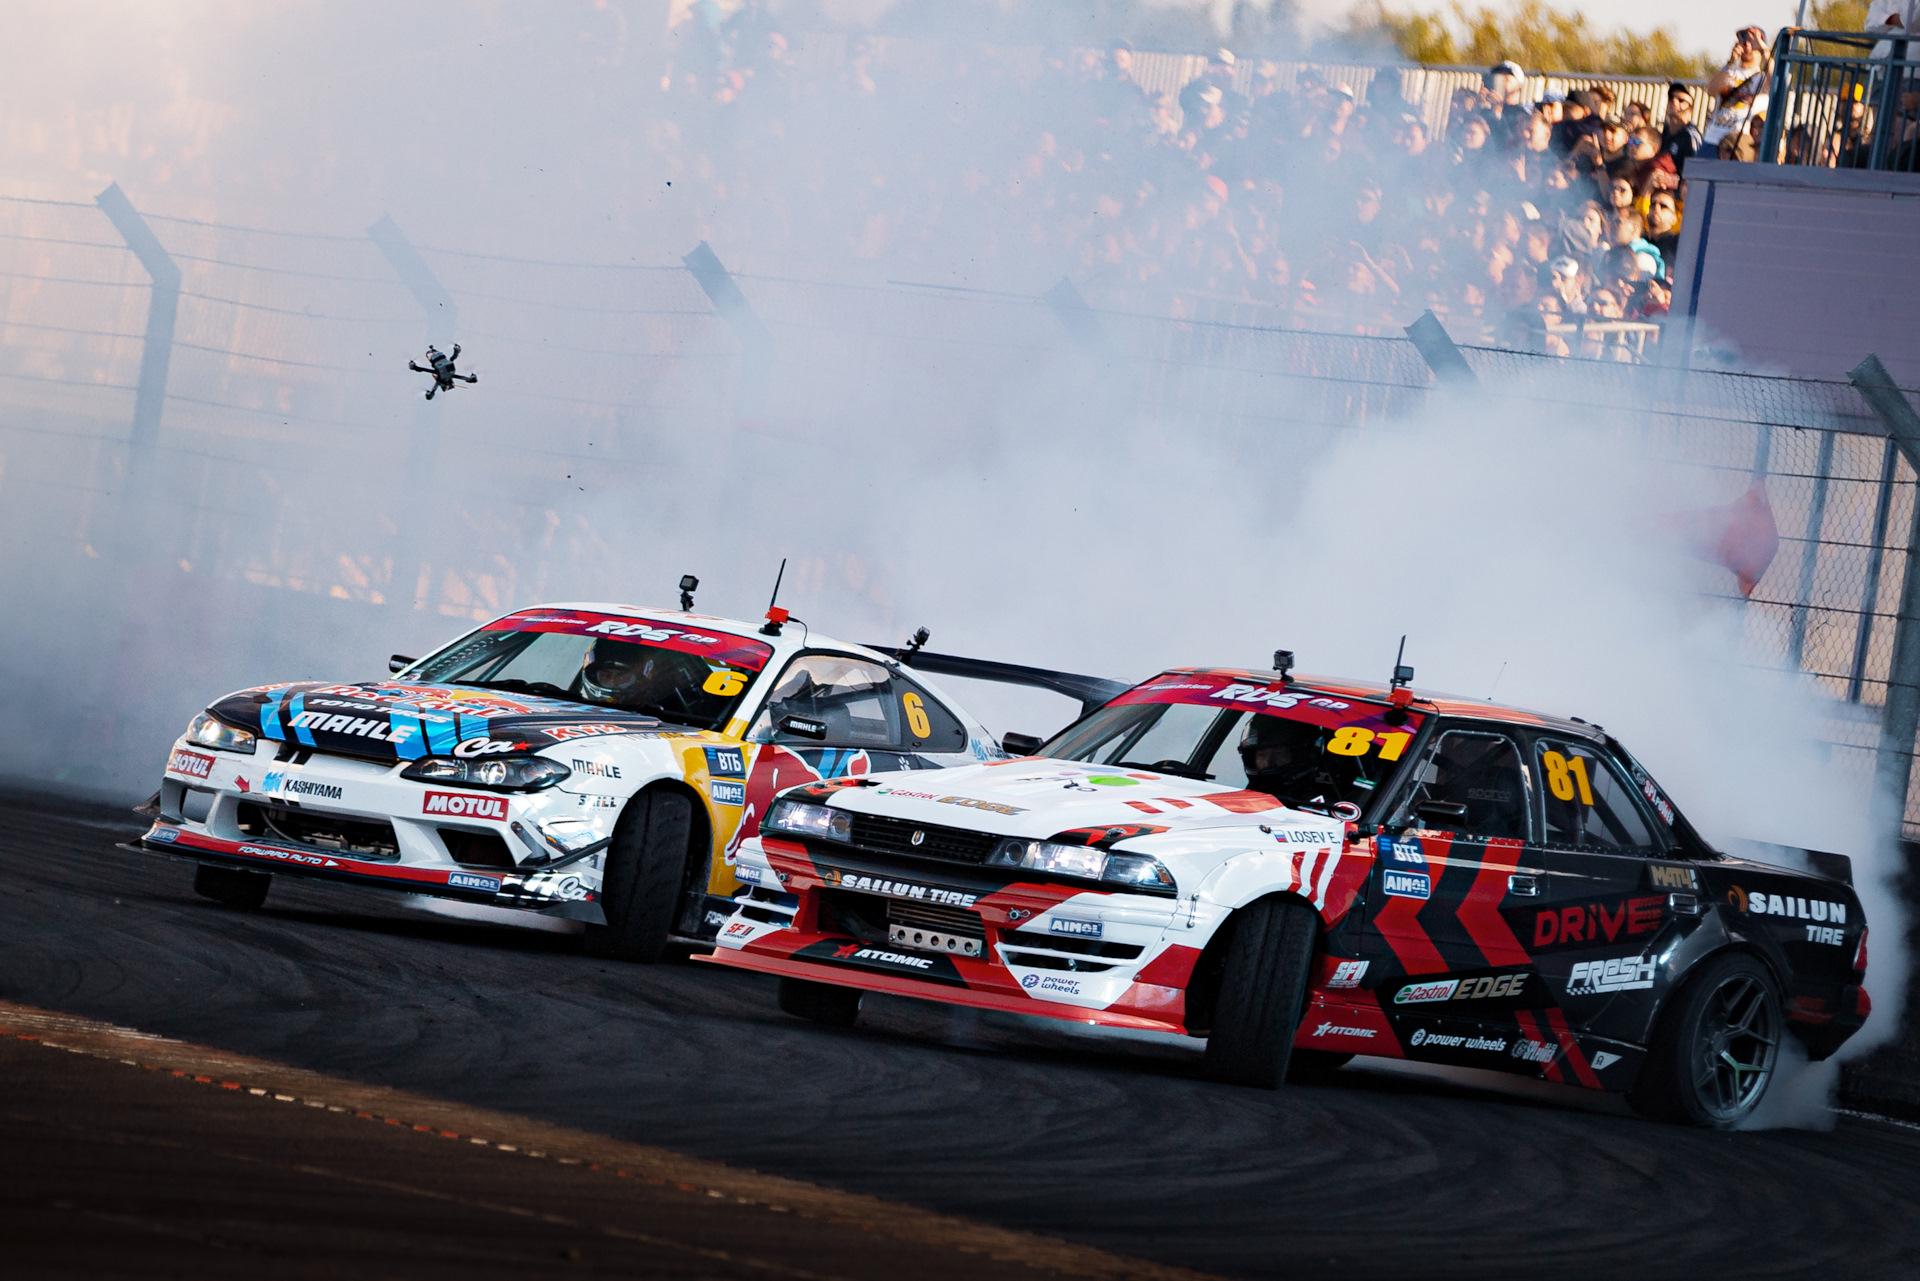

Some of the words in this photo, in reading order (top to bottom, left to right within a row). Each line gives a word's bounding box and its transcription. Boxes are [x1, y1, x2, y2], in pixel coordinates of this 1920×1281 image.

[585, 620, 685, 642] RDS
[702, 670, 749, 697] 6
[1209, 683, 1315, 709] RDS
[902, 692, 931, 739] 6
[288, 710, 417, 744] MAHLE
[790, 720, 817, 733] MAHLE
[1327, 726, 1412, 761] 81
[572, 758, 622, 779] MAHLE
[717, 752, 742, 772] ВТБ
[1543, 750, 1594, 806] 81
[284, 779, 342, 799] KASHIYAMA
[713, 784, 743, 801] AIMOL
[428, 795, 505, 818] MOTUL
[1287, 830, 1326, 843] LOSEV
[1392, 843, 1423, 864] ВТБ
[451, 874, 499, 890] AIMOL
[841, 873, 926, 899] SAILUN
[930, 888, 978, 907] TIRE
[1386, 875, 1428, 893] AIMOL
[1748, 891, 1846, 925] SAILUN
[1051, 919, 1101, 934] AIMOL
[1806, 925, 1845, 947] TIRE
[854, 948, 934, 969] ATOMIC
[1041, 981, 1080, 995] wheels
[1043, 976, 1080, 986] power
[1408, 984, 1452, 1001] Castrol
[1453, 973, 1530, 1000] EDGE
[1326, 1026, 1377, 1038] ATOMIC
[1423, 1032, 1465, 1048] power
[1465, 1036, 1507, 1051] wheels
